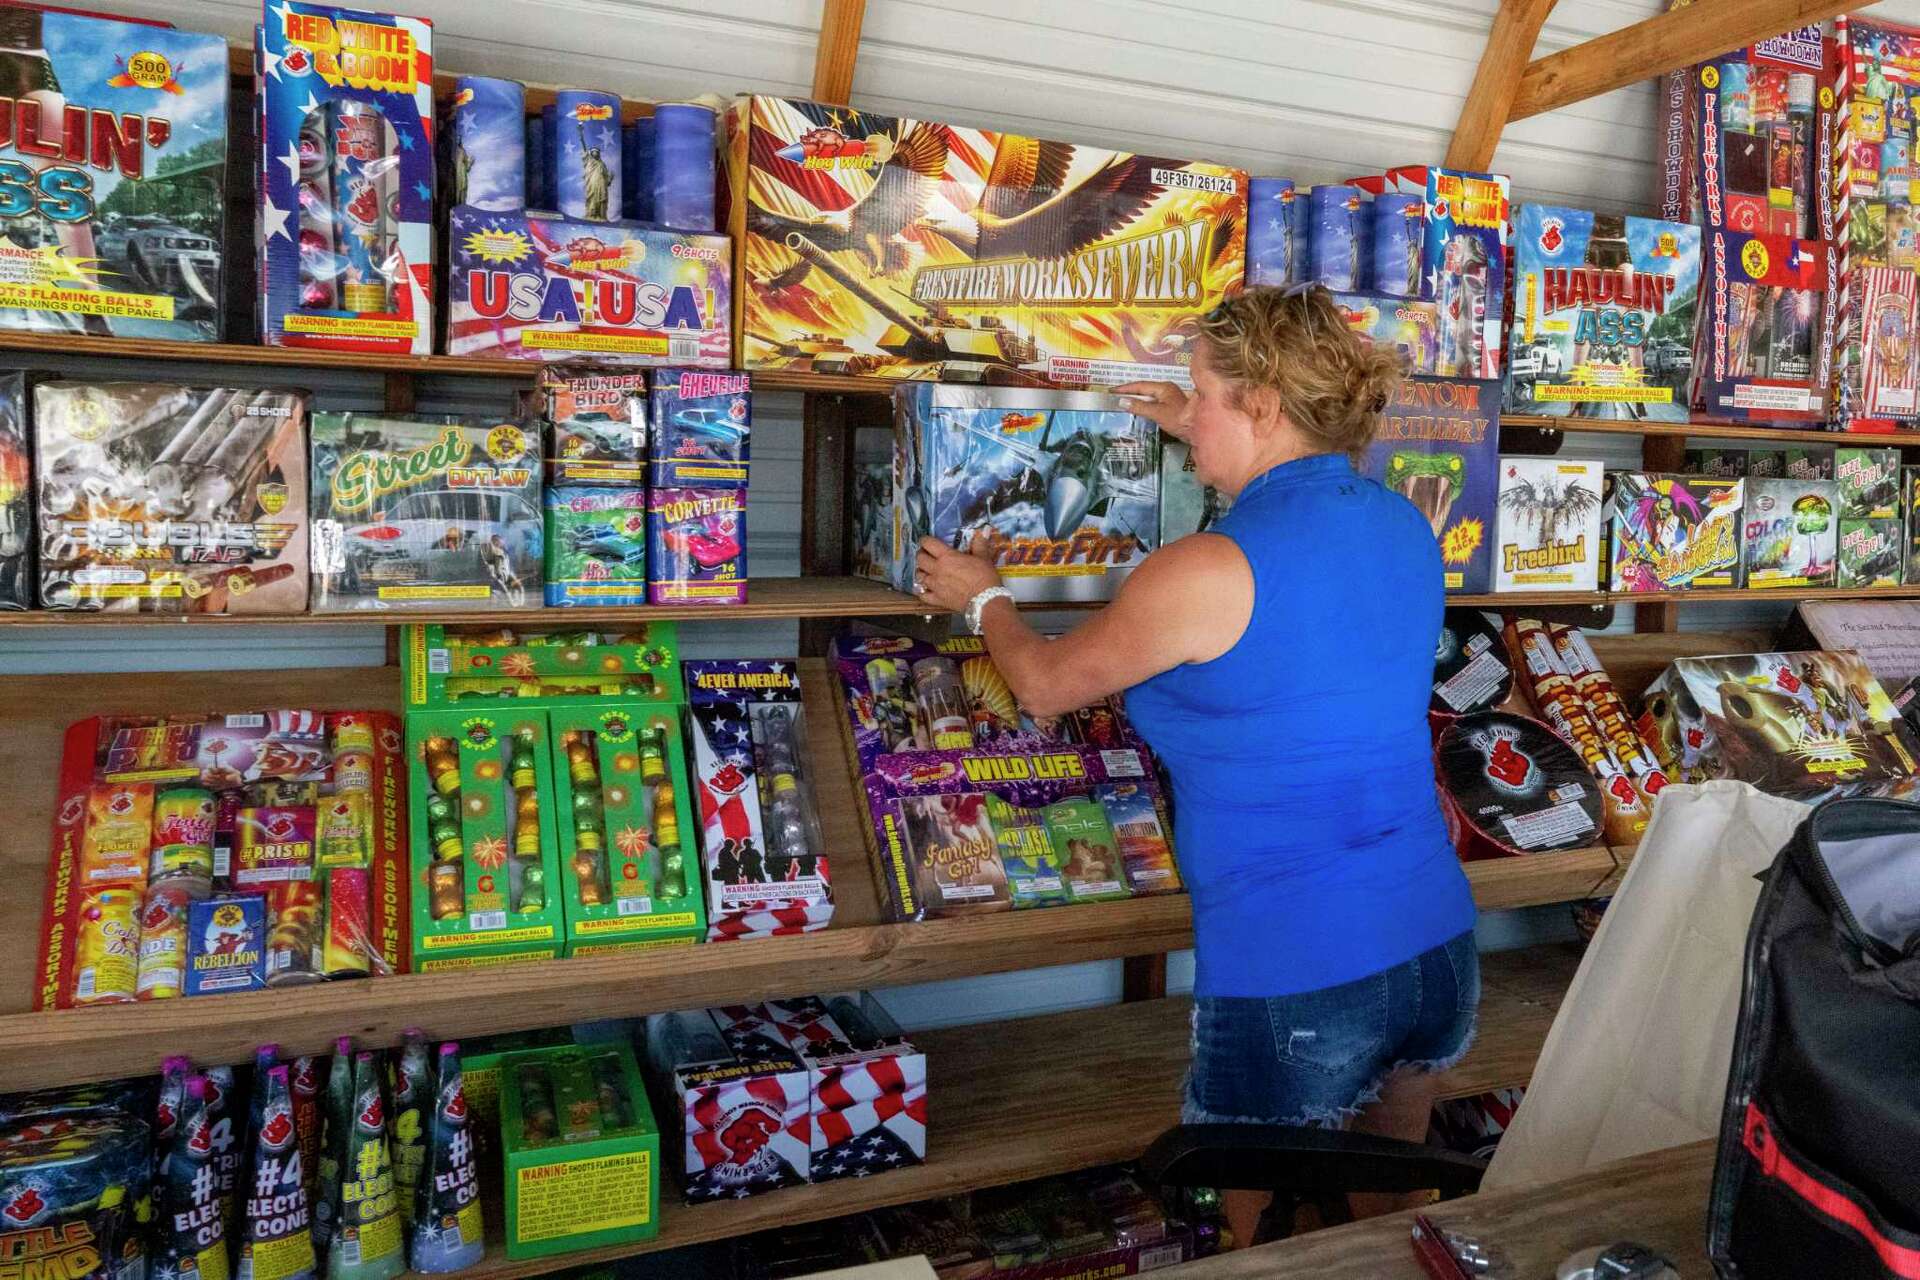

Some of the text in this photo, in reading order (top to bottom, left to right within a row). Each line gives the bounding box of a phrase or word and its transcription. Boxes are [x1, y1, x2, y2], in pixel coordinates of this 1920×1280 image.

[287, 14, 409, 54] RED WHITE
[1756, 40, 1822, 64] SHOWDOWN
[133, 59, 166, 75] 500
[316, 50, 409, 84] & BOOM
[132, 72, 167, 84] GRAM
[804, 153, 874, 171] Hog Wild
[1663, 111, 1685, 222] SHOWDOW
[1703, 93, 1721, 226] FIREWORKS
[1156, 171, 1233, 193] 49F367/261/24
[1463, 200, 1498, 221] BOOM
[671, 244, 719, 260] 9 SHOTS
[914, 222, 1206, 299] #BESTFIREWORKSEVER!
[31, 289, 101, 305] FLAMING
[105, 296, 153, 308] BALLS
[1543, 267, 1676, 316] HAULIN'
[72, 304, 91, 313] ON
[94, 305, 125, 316] SIDE
[127, 308, 168, 319] PANEL
[289, 316, 339, 328] WARNING
[1574, 309, 1645, 346] ASS
[532, 332, 580, 342] WARNING
[1052, 359, 1090, 369] WARNING
[567, 375, 644, 393] THUNDER
[680, 372, 750, 400] CHEVELLE
[1051, 374, 1091, 384] IMPORTANT
[576, 392, 622, 407] BIRD
[1544, 386, 1590, 395] WARNING
[246, 407, 292, 418] 25 SHOTS
[335, 430, 468, 508] Street
[448, 468, 531, 488] OUTLAW
[664, 496, 736, 524] CORVETTE
[1452, 526, 1470, 545] 12
[1450, 538, 1475, 556] PACK
[1503, 535, 1587, 573] Freebird
[714, 572, 738, 580] SHOT
[722, 564, 736, 573] 16
[1840, 622, 1885, 633] The Second
[698, 672, 792, 689] 4EVER AMERICA
[961, 753, 1085, 781] WILD LIFE
[239, 842, 310, 863] #PRISM
[1002, 829, 1054, 857] SPLASH
[924, 838, 993, 868] Fantasy
[622, 863, 638, 881] 6
[477, 875, 495, 894] 6
[725, 885, 760, 894] WARNING
[582, 919, 625, 930] WARNING
[431, 933, 477, 944] WARNING
[576, 945, 620, 956] WARNING
[193, 951, 259, 970] REBELLION
[426, 958, 473, 970] WARNING
[462, 1069, 497, 1083] ARNING
[396, 1108, 422, 1146] 4
[521, 1154, 647, 1181] WARNING SHOOTS FLAMING BALLS
[191, 1164, 214, 1206] #
[255, 1208, 309, 1239] CONE
